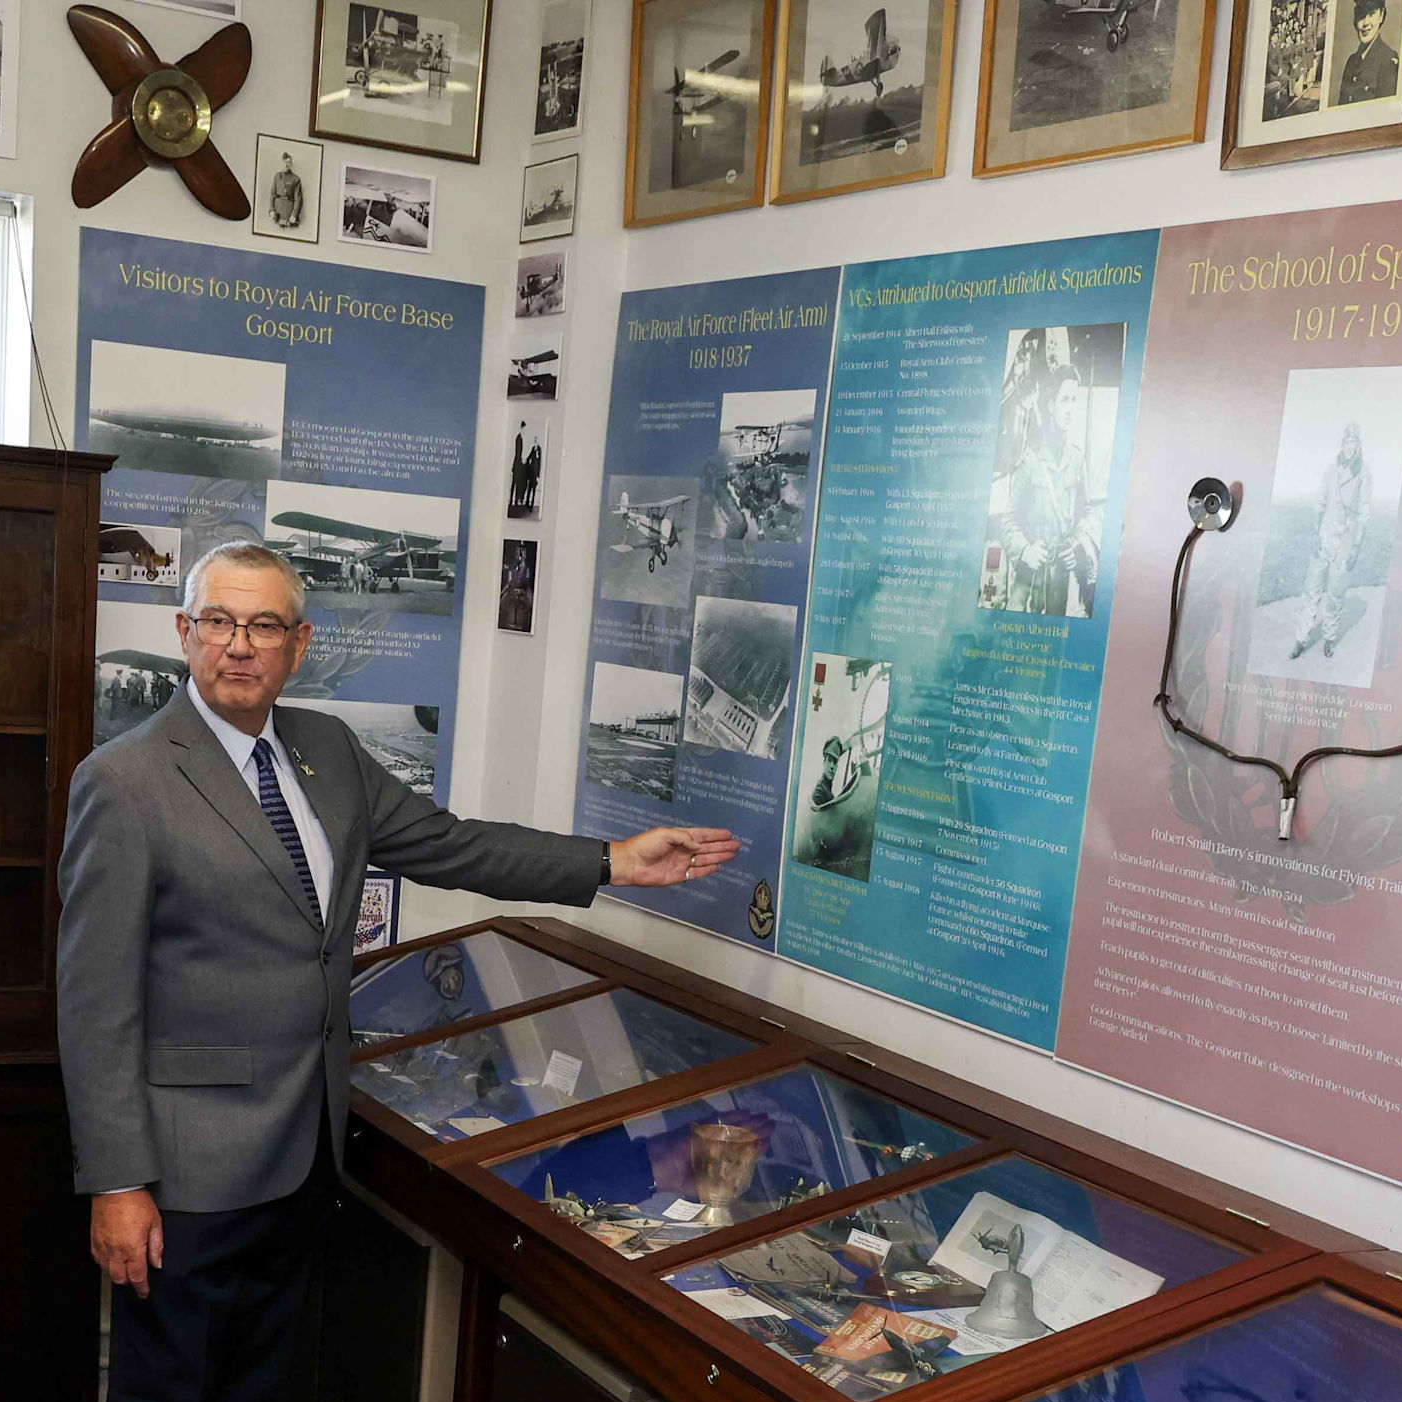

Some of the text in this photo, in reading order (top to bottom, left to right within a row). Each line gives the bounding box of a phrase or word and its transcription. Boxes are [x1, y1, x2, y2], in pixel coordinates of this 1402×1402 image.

[850, 263, 1142, 307] VCs Attributed to Gosport Airfield & Squadrons
[1188, 260, 1234, 295] The
[1243, 248, 1332, 292] School
[1338, 246, 1369, 285] of
[119, 264, 454, 330] Visitors to Royal Air Force Base
[246, 314, 333, 345] Gosport
[628, 303, 827, 343] The Royal Air Force (Fleet Air Arm)
[689, 345, 751, 369] 1918-1937
[1118, 852, 1155, 868] standard
[1156, 860, 1174, 873] dual
[1175, 865, 1205, 880] control
[1241, 880, 1258, 893] The
[1260, 887, 1282, 899] Avro
[1151, 829, 1184, 845] Robert
[1187, 836, 1215, 854] Smith
[1217, 843, 1254, 861] Barry's
[1255, 849, 1320, 876] innovations
[1321, 864, 1338, 879] for
[1339, 869, 1375, 890] Flying
